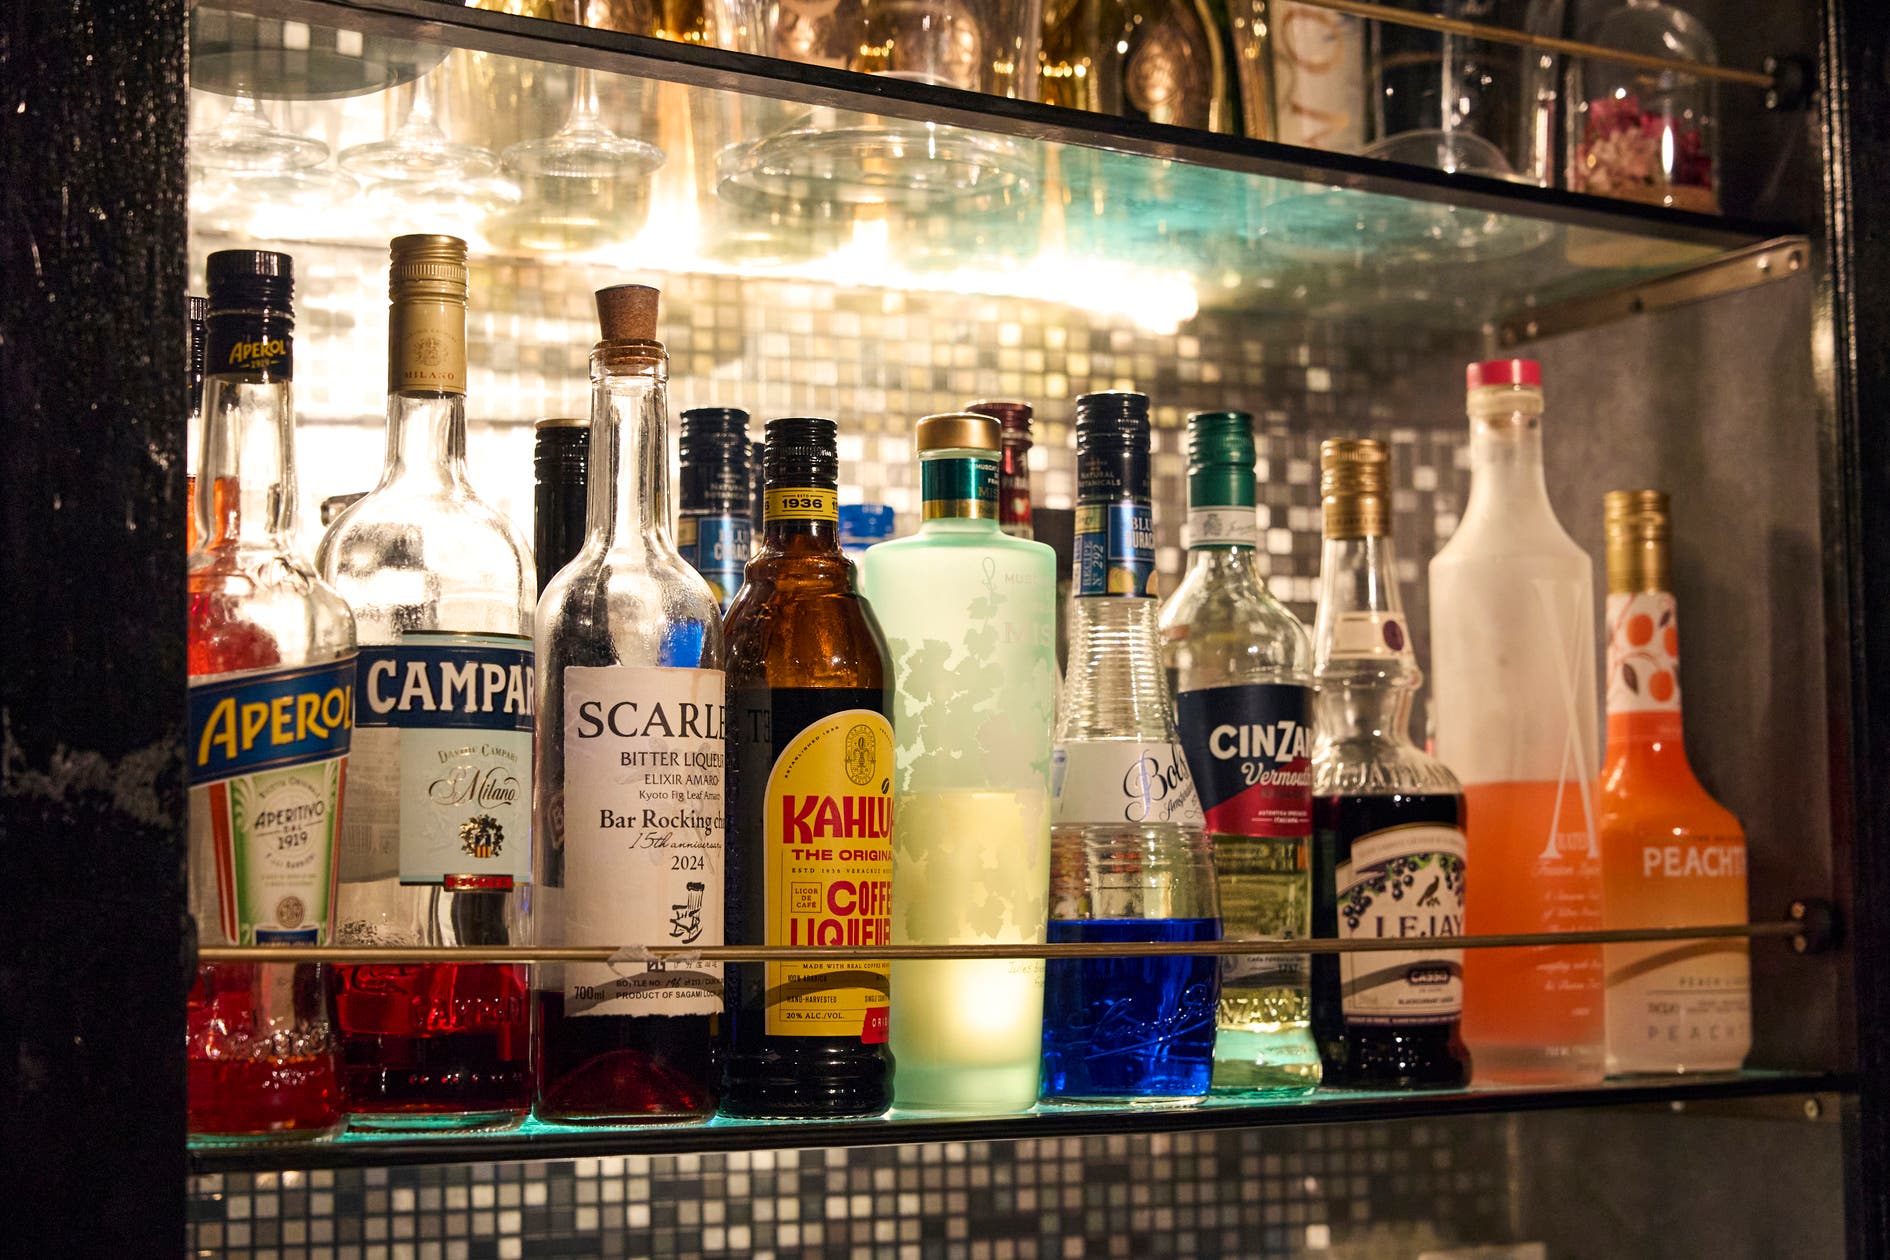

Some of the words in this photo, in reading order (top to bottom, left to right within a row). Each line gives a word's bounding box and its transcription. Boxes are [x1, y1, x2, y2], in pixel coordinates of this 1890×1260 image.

[228, 339, 286, 365] APEROL
[404, 371, 454, 380] MILANO
[782, 498, 823, 509] 1936
[1093, 544, 1104, 569] 292
[197, 685, 352, 767] APEROL
[620, 752, 679, 767] BITTER
[429, 767, 520, 810] Milano
[644, 773, 683, 785] ELIXIR
[686, 775, 719, 786] AMARO
[1123, 742, 1191, 823] Bols
[639, 790, 669, 802] Kyoto
[671, 790, 685, 802] Fig
[686, 790, 703, 800] Leaf
[254, 800, 324, 830] APERITIVO
[600, 809, 636, 829] Bar
[642, 809, 713, 836] Rocking
[782, 795, 894, 846] KAHLU
[278, 830, 308, 850] 1919
[629, 831, 674, 850] 15th
[671, 855, 704, 871] 2024
[792, 849, 833, 861] THE
[616, 992, 660, 1000] PRODUCT
[662, 991, 673, 999] OF
